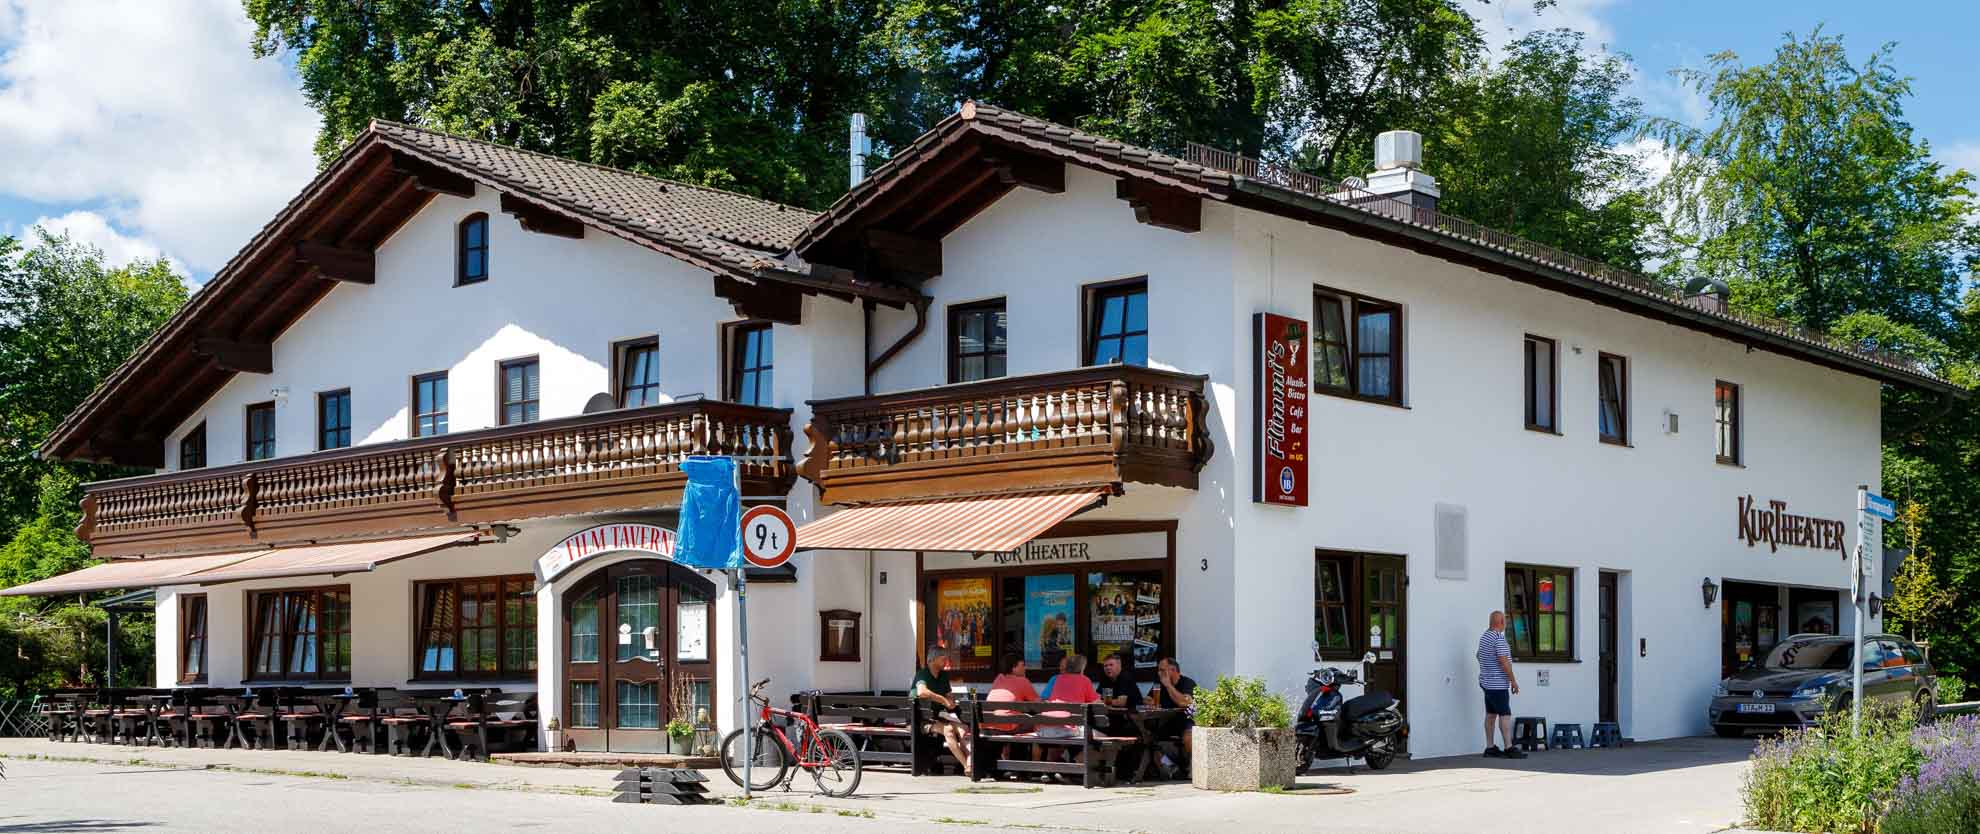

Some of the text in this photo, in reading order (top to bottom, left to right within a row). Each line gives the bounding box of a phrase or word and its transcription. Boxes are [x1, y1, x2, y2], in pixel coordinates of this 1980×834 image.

[1267, 339, 1285, 460] Flimmi's
[1287, 387, 1306, 400] Bistro
[1290, 422, 1303, 433] Bar
[755, 523, 778, 550] 9 t
[1738, 494, 1847, 560] KURTHEATER
[565, 527, 606, 561] FILM
[1200, 558, 1208, 572] 3
